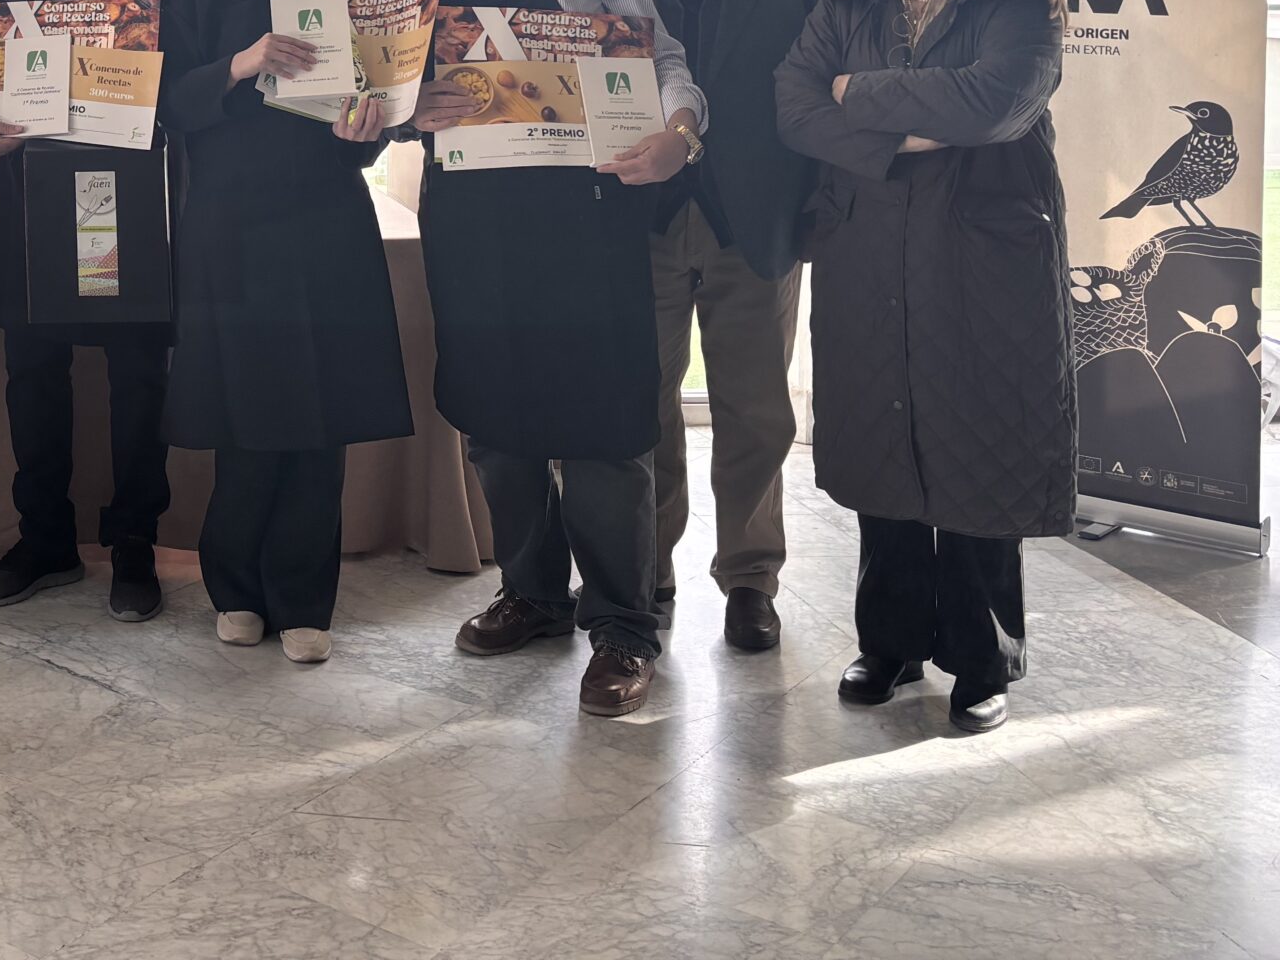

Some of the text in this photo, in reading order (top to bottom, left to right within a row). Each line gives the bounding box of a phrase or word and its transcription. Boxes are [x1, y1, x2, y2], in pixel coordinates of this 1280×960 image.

[43, 2, 105, 13] Concurso
[357, 5, 374, 16] de
[44, 12, 111, 24] de Recetas
[520, 10, 592, 27] Concurso
[463, 6, 528, 61] X
[521, 22, 597, 39] de Recetas
[1074, 27, 1130, 41] ORIGEN
[1083, 44, 1121, 56] EXTRA
[74, 57, 143, 76] X Concurso de
[97, 76, 132, 87] Recetas
[88, 87, 135, 100] 300 euros
[69, 104, 86, 114] MIO
[542, 128, 585, 138] PREMIO
